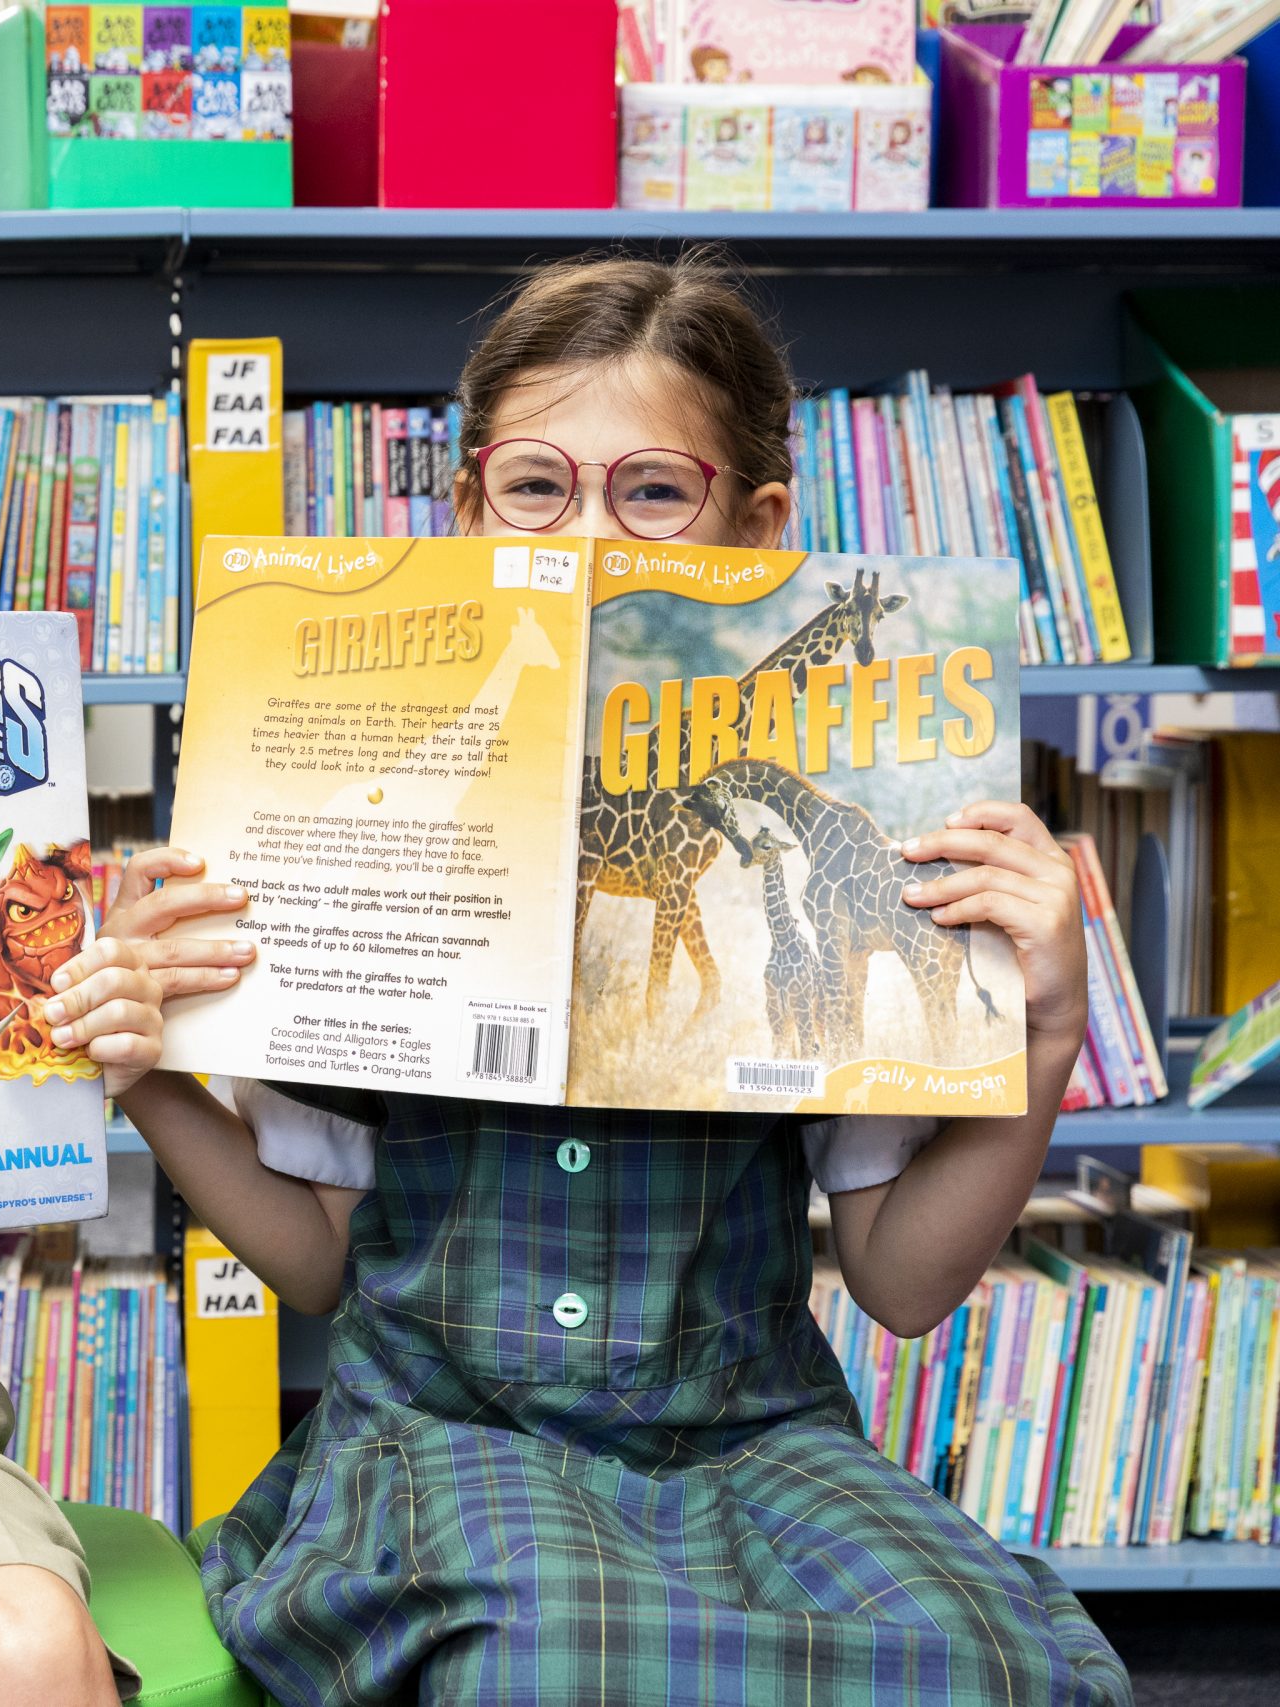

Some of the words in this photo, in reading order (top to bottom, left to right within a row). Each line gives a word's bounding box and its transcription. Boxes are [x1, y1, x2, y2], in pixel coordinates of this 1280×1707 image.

[223, 361, 256, 378] JF
[213, 394, 263, 411] EAA
[213, 428, 262, 444] FAA
[254, 546, 322, 571] Animal
[328, 552, 377, 575] Lives
[535, 555, 570, 568] 599.6
[635, 551, 706, 580] Animal
[713, 563, 765, 586] Lives
[293, 600, 483, 678] GIRAFFES
[267, 697, 310, 709] Giraffes
[314, 702, 331, 710] are
[335, 703, 361, 711] some
[365, 702, 376, 711] of
[380, 701, 396, 712] the
[400, 702, 448, 716] strangest
[452, 704, 470, 714] and
[474, 704, 498, 715] most
[263, 713, 303, 727] amazing
[307, 714, 345, 725] animals
[366, 716, 396, 727] Earth.
[401, 717, 427, 728] Their
[431, 718, 463, 730] hearts
[467, 722, 484, 730] are
[488, 721, 499, 731] 25
[600, 645, 996, 797] GIRAFFES
[252, 727, 279, 738] times
[283, 728, 319, 740] heavier
[324, 730, 345, 740] than
[361, 731, 393, 742] human
[397, 733, 426, 745] heart,
[432, 734, 455, 745] their
[460, 735, 481, 746] tails
[485, 739, 509, 749] grow
[251, 742, 260, 752] to
[265, 743, 295, 756] nearly
[299, 746, 313, 755] 2.5
[318, 746, 353, 757] metres
[357, 746, 378, 761] long
[382, 748, 400, 758] and
[404, 748, 426, 762] they
[430, 752, 447, 760] are
[467, 751, 483, 761] tall
[487, 751, 508, 762] that
[265, 758, 286, 771] they
[291, 759, 317, 770] could
[320, 760, 341, 771] look
[346, 761, 364, 772] into
[378, 764, 450, 778] second-storey
[454, 766, 491, 778] window!
[235, 919, 267, 932] Gallop
[270, 922, 291, 932] with
[294, 923, 310, 934] the
[312, 925, 349, 937] giraffes
[352, 930, 383, 939] across
[386, 930, 402, 941] the
[404, 932, 439, 943] African
[442, 937, 489, 947] savannah
[260, 936, 271, 944] at
[273, 938, 308, 947] speeds
[310, 939, 321, 948] of
[324, 942, 336, 952] up
[339, 941, 349, 951] to
[352, 942, 365, 952] 60
[368, 943, 418, 956] kilometres
[421, 949, 434, 957] an
[437, 948, 461, 959] hour.
[293, 1015, 321, 1026] Other
[324, 1017, 346, 1028] titles
[349, 1019, 358, 1029] in
[361, 1020, 377, 1031] the
[380, 1023, 411, 1034] series:
[271, 1026, 320, 1040] Crocodiles
[322, 1032, 342, 1042] and
[344, 1033, 388, 1047] Alligators
[399, 1038, 431, 1051] Eagles
[776, 1086, 812, 1094] 014523
[862, 1065, 915, 1092] Sally
[923, 1072, 1007, 1099] Morgan
[214, 1262, 243, 1278] JF
[204, 1294, 256, 1312] HAA
